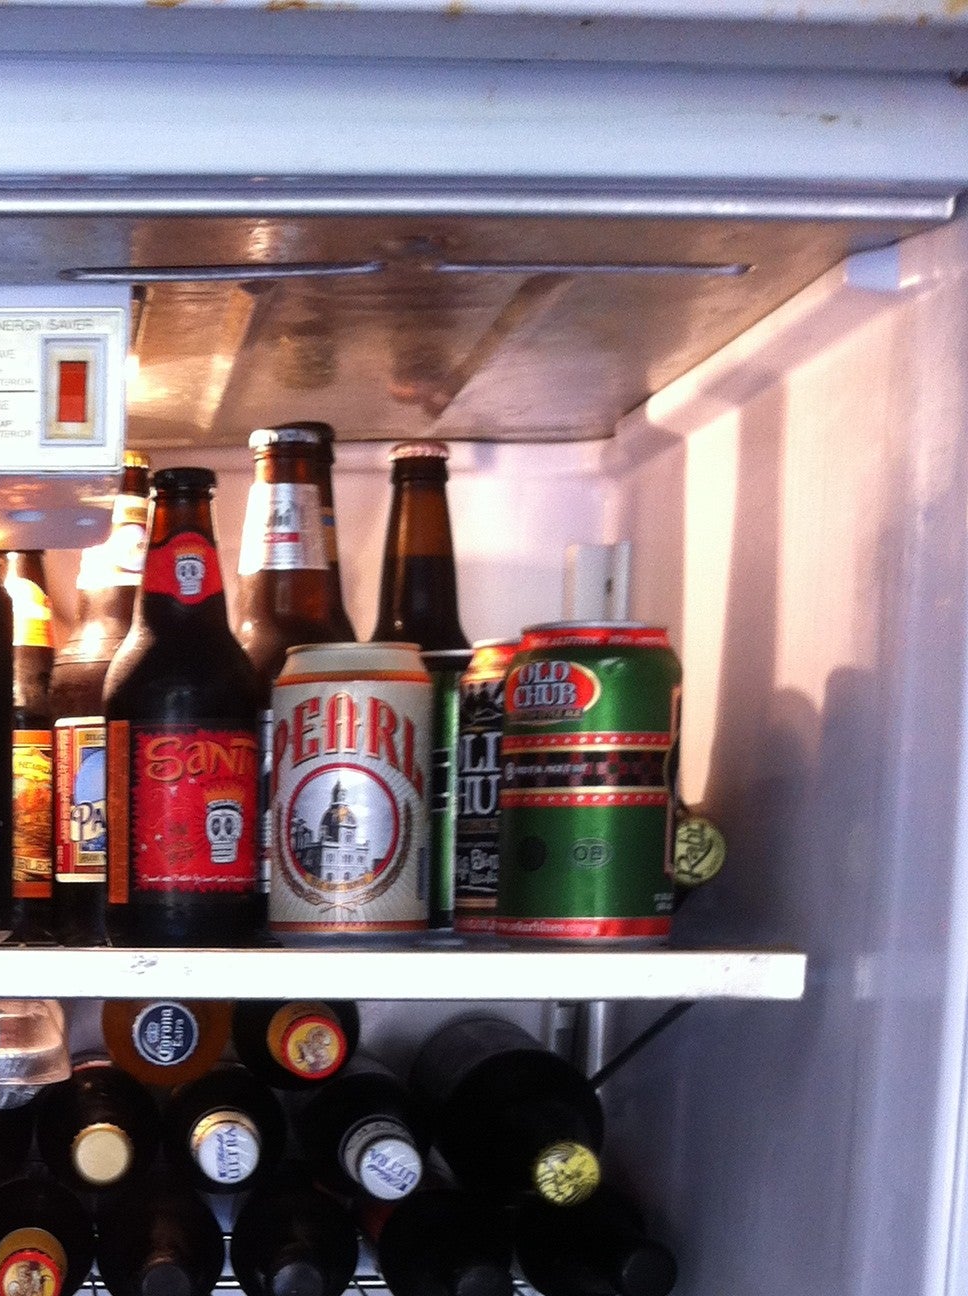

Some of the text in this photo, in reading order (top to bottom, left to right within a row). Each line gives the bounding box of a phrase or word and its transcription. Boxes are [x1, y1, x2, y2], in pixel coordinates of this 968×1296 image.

[46, 318, 95, 331] SAVER
[518, 659, 572, 686] OLD
[512, 681, 579, 708] CHUB
[271, 690, 425, 801] PEARL
[158, 1008, 175, 1061] Corona
[172, 1018, 184, 1048] Extra
[226, 1125, 241, 1180] ULTRA
